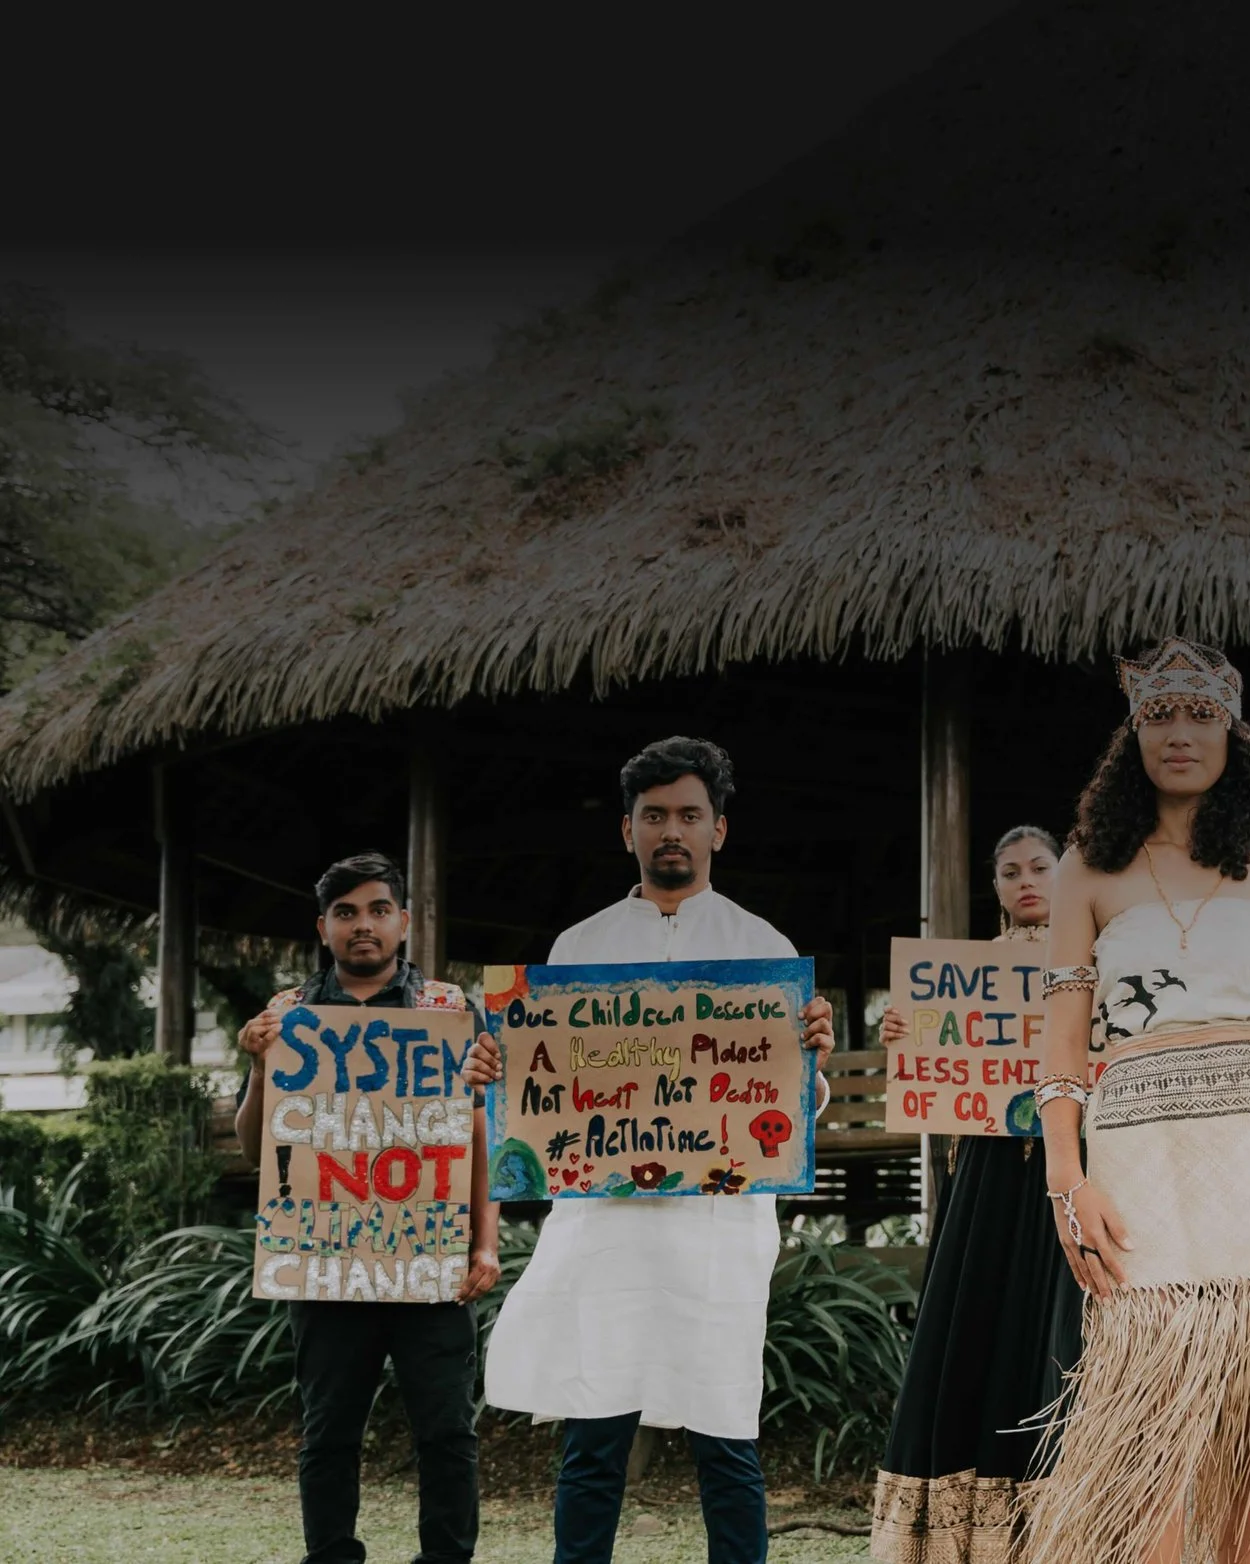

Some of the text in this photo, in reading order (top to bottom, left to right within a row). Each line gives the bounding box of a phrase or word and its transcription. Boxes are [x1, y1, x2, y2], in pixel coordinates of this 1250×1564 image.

[910, 961, 1000, 1001] SAVE
[507, 992, 787, 1029] Our Children Deserve
[913, 1009, 1105, 1052] PACIFC
[271, 1006, 472, 1097] SYSTEM
[529, 1033, 772, 1081] A Healthy Planet
[897, 1053, 969, 1085] LESS
[270, 1093, 473, 1150] CHANGE
[903, 1090, 937, 1120] OF
[275, 1144, 467, 1201] ! NOT
[257, 1197, 470, 1256] CLIMATE
[258, 1254, 470, 1302] CHANGE
